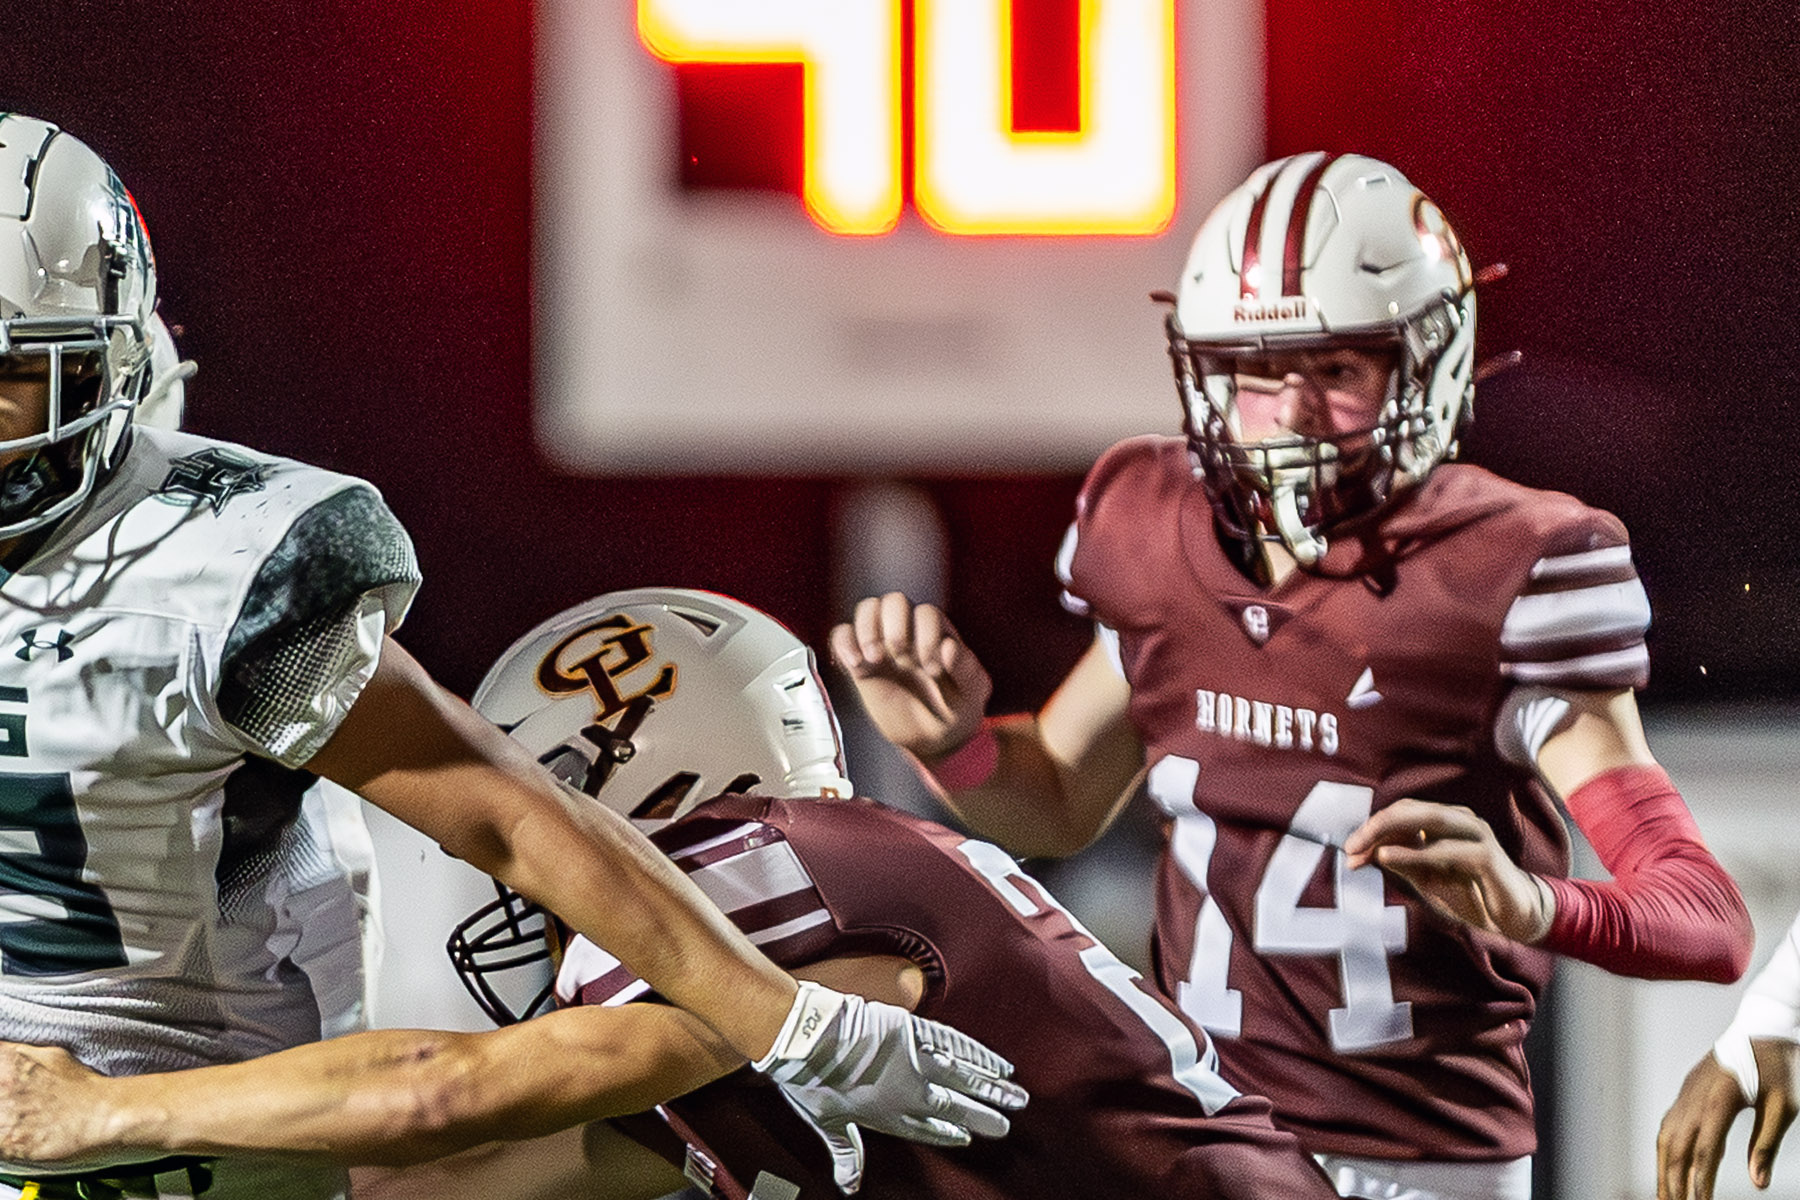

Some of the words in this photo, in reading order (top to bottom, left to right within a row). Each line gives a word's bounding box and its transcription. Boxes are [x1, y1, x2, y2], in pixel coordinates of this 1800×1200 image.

[1233, 301, 1308, 323] Riddell
[1196, 689, 1339, 756] HORNETS
[1148, 754, 1414, 1054] 14
